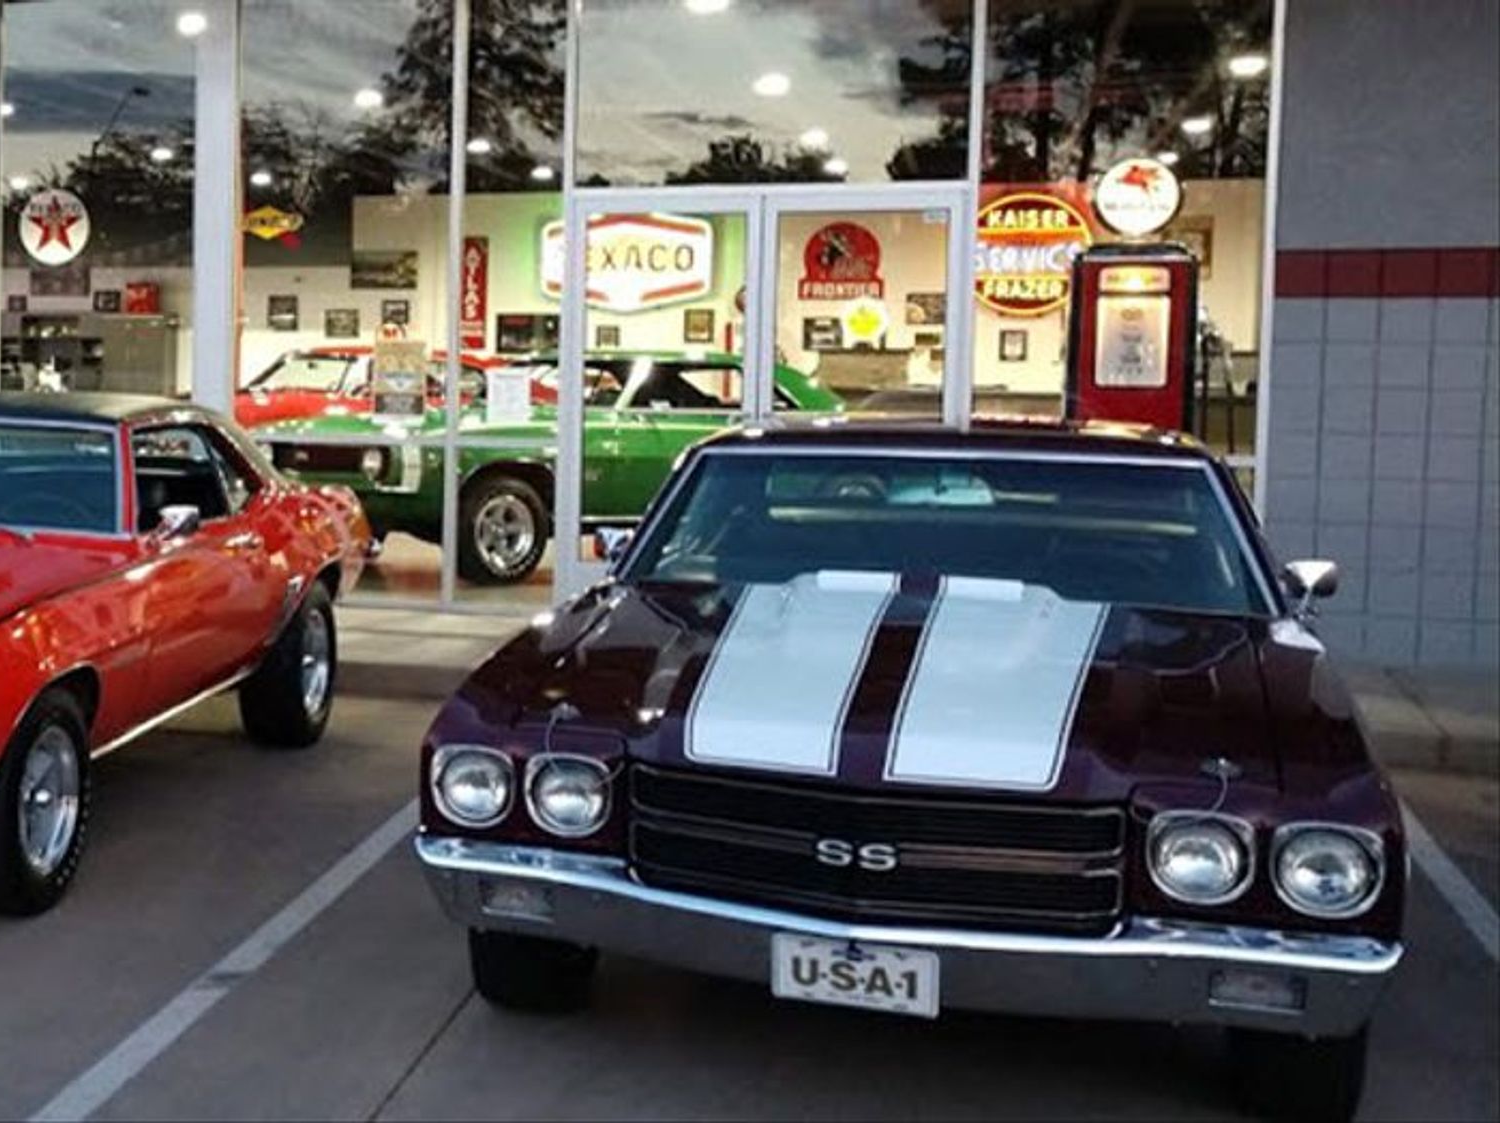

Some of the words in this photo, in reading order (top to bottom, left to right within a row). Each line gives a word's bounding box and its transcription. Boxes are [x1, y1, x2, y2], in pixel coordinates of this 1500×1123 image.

[987, 209, 1068, 229] KAISER
[584, 244, 694, 272] EXACO
[464, 246, 481, 319] ATLAS
[802, 281, 880, 298] FRONTIER
[983, 279, 1064, 299] FRAZER
[817, 839, 897, 871] SS
